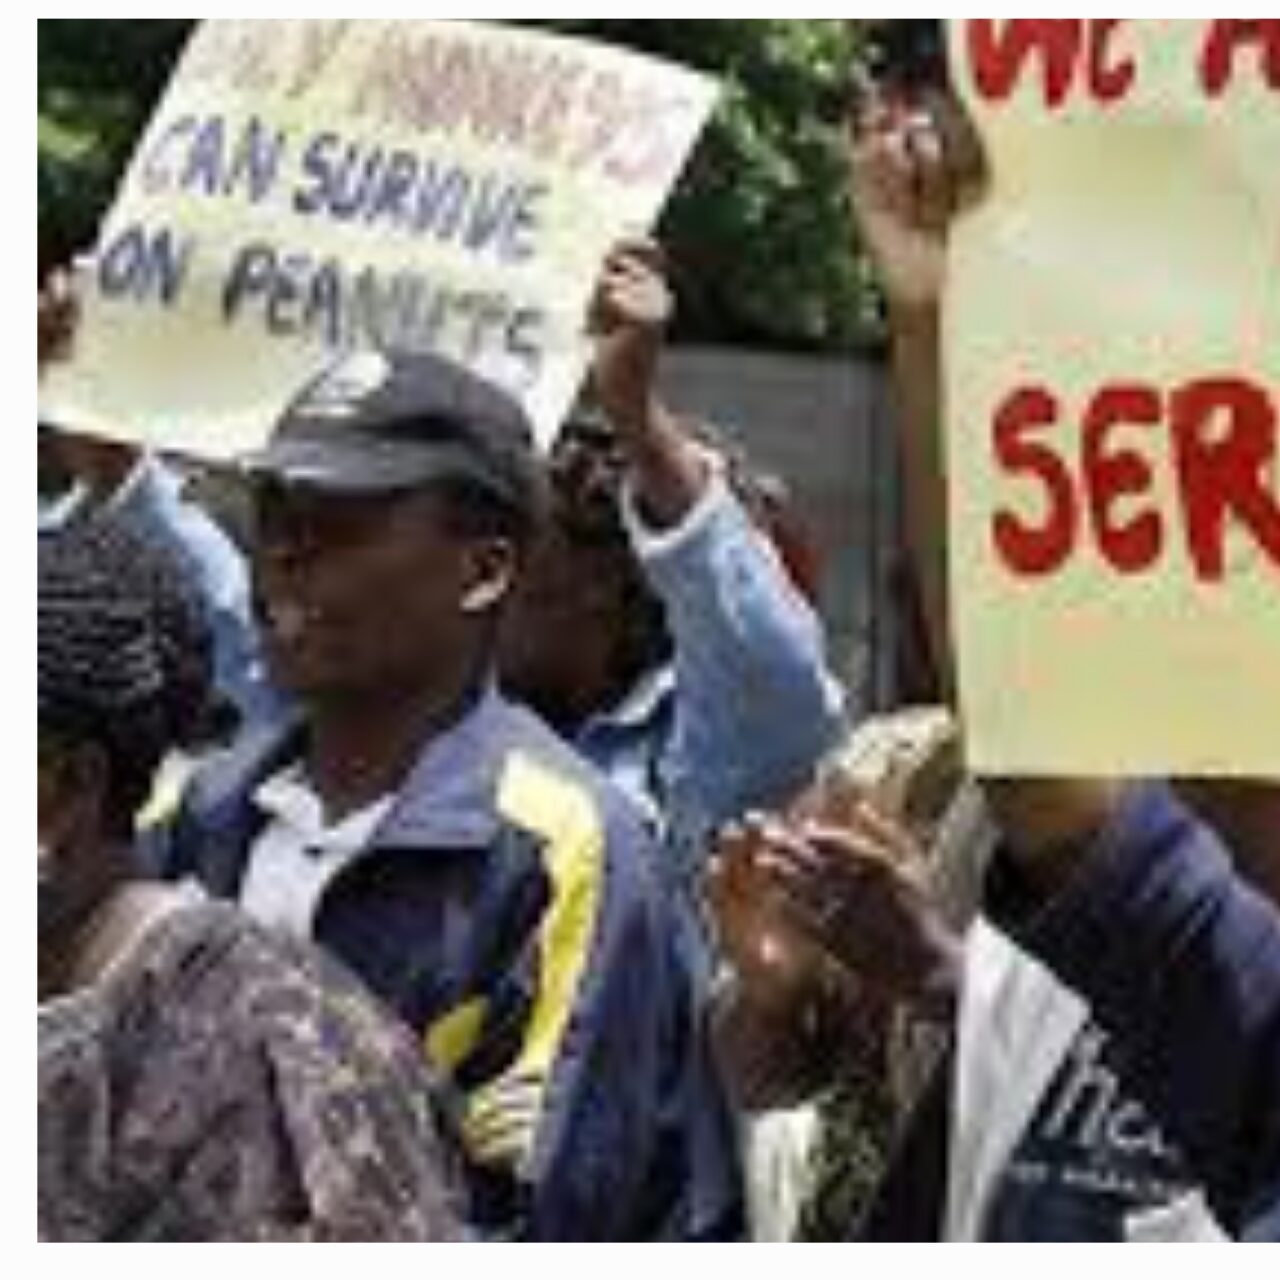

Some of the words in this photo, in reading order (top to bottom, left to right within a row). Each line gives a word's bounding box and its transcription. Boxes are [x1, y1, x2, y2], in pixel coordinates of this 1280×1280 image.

[968, 20, 1135, 108] WE
[143, 116, 284, 204] CAN
[293, 132, 551, 265] SURVIVE
[101, 225, 190, 306] ON
[222, 243, 544, 378] PEANUTS
